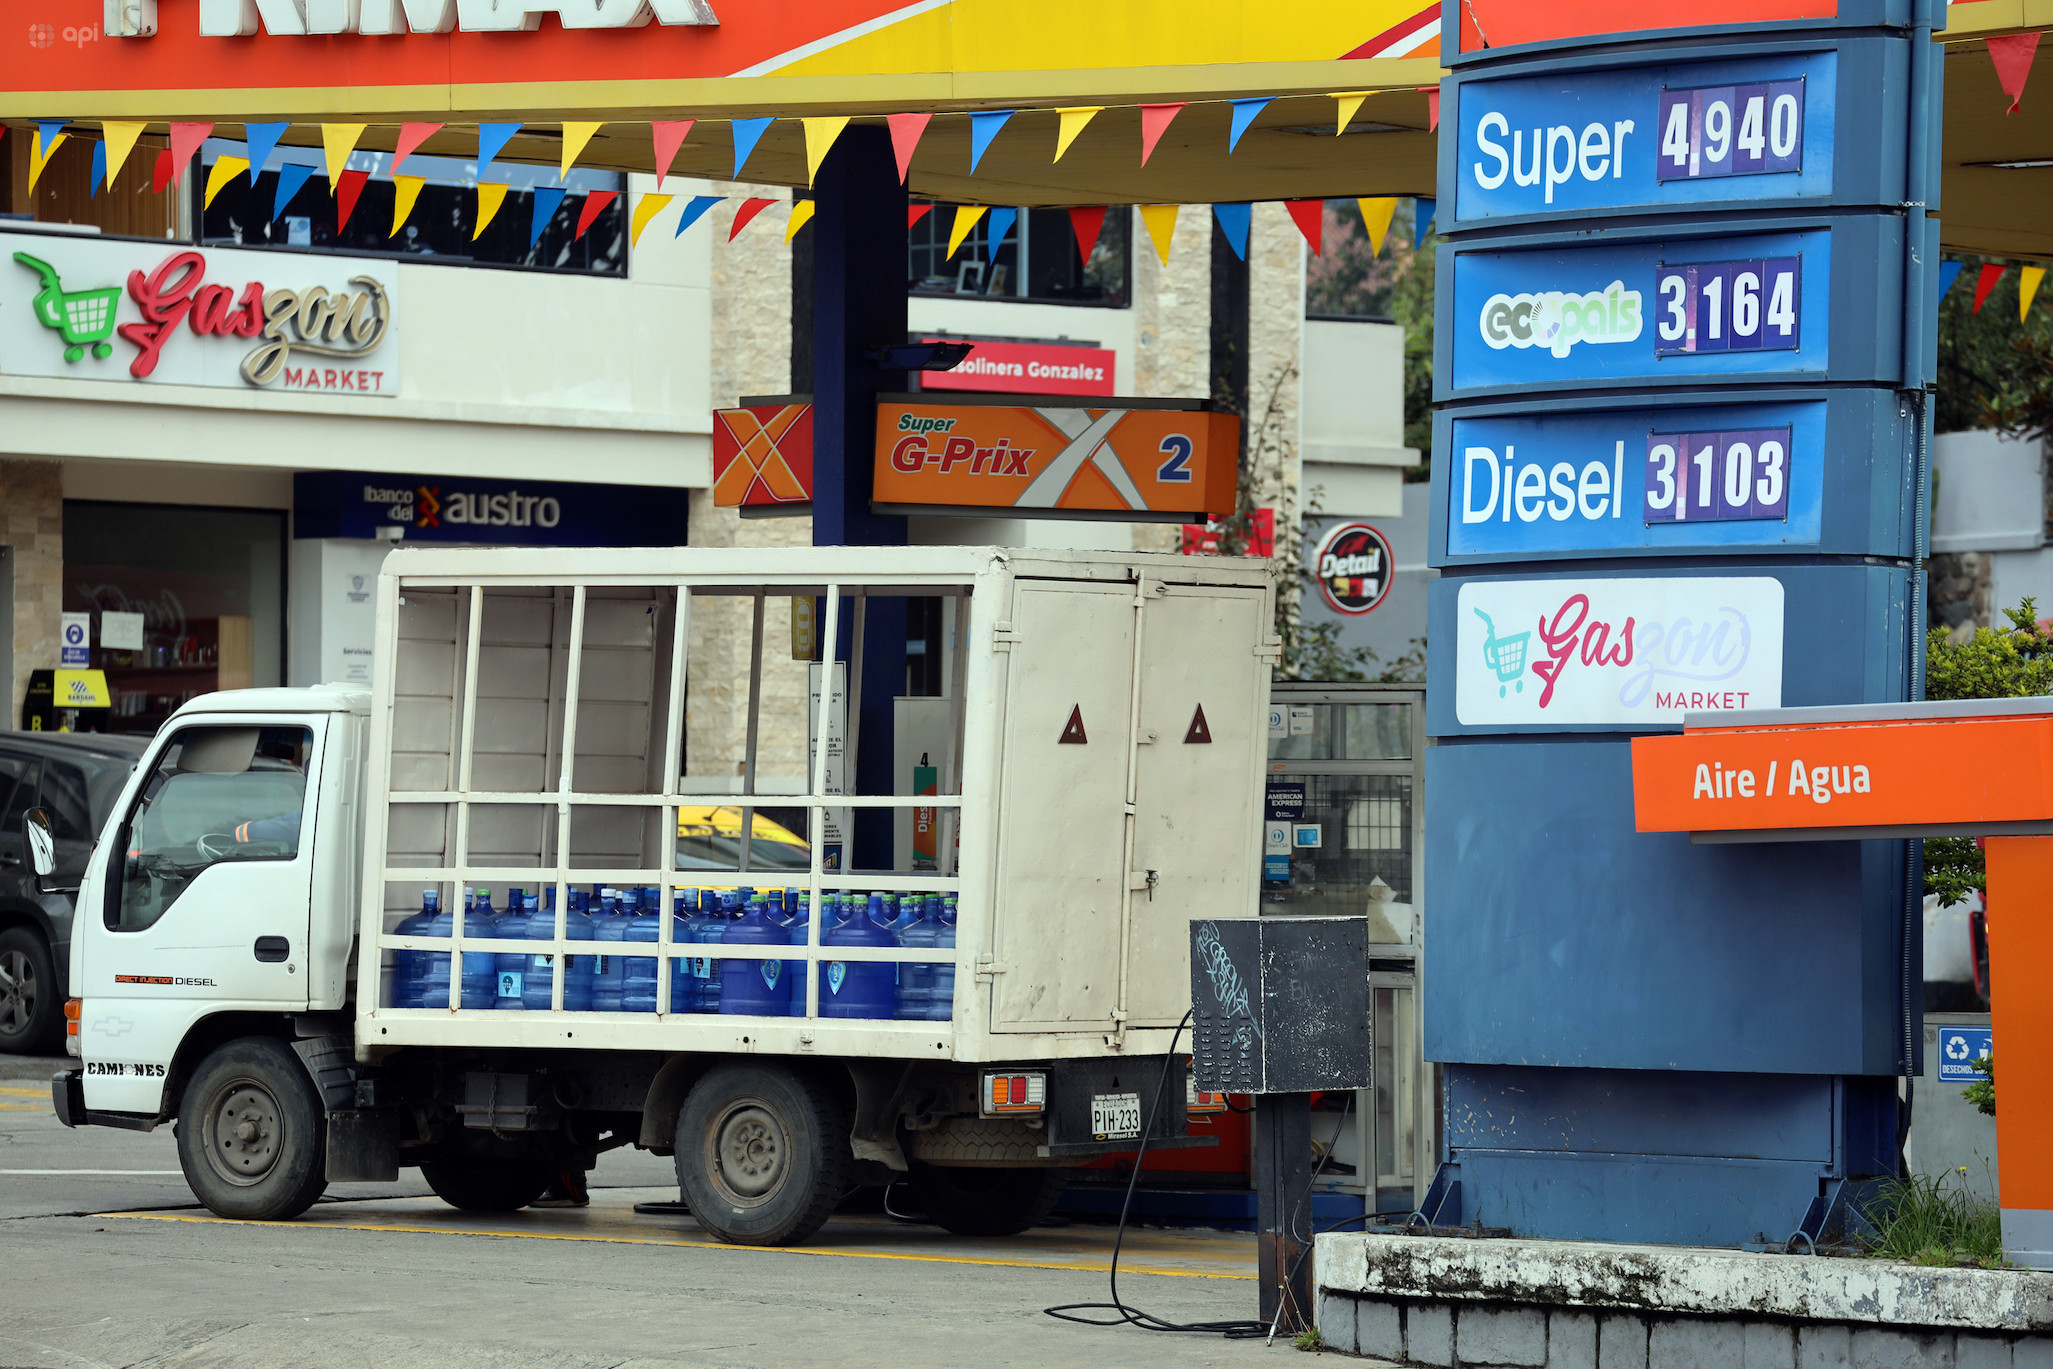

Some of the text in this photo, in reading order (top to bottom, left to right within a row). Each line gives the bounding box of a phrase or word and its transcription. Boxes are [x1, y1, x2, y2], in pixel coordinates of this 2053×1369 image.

[1661, 94, 1798, 166] 4.940
[1474, 111, 1635, 204] Super
[118, 251, 390, 386] Gaszon
[1658, 271, 1796, 341] 3.164
[284, 367, 384, 391] MARKET
[1027, 361, 1104, 381] Gonzalez
[898, 412, 957, 434] Super
[891, 435, 1036, 477] G-Prix
[1156, 433, 1194, 483] 2
[1647, 440, 1785, 510] 3.103
[1462, 440, 1625, 524] Diesel
[388, 505, 413, 522] del
[444, 490, 560, 528] austro
[1320, 547, 1382, 579] Detail
[1531, 593, 1752, 709] Gaszon
[1655, 691, 1750, 710] MARKET
[920, 752, 929, 768] 4
[1692, 758, 1872, 804] Aire / Agua
[115, 975, 138, 983] DIRECT
[175, 977, 218, 987] DIESEL
[1094, 1109, 1139, 1131] PIH-233
